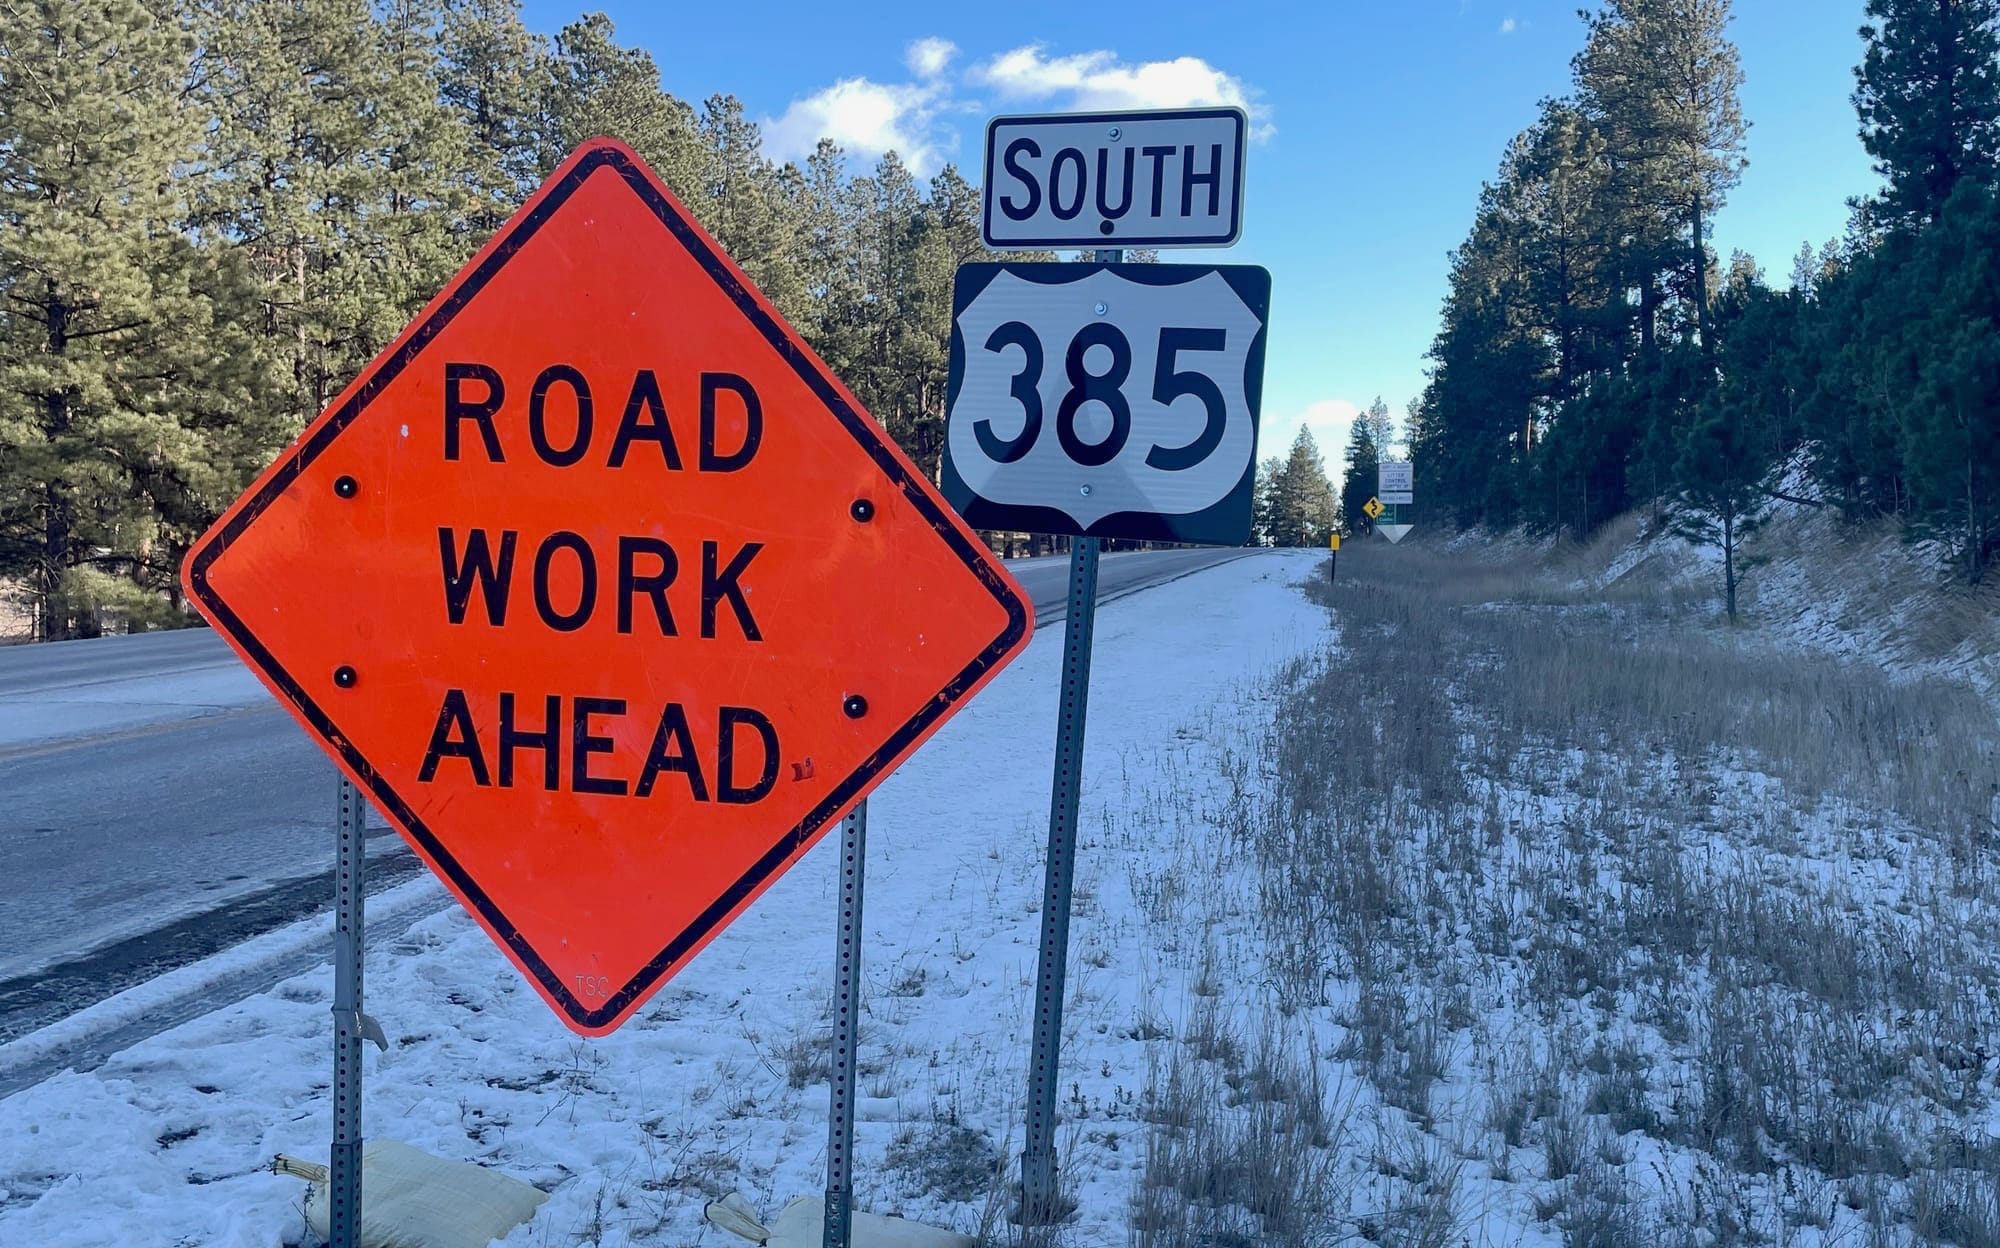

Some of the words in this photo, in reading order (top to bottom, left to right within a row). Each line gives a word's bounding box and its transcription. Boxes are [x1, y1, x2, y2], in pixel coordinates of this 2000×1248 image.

[999, 138, 1222, 221] SOUTH
[444, 362, 763, 473] ROAD
[973, 320, 1227, 471] 385
[438, 527, 765, 642] WORK
[417, 688, 780, 805] AHEAD
